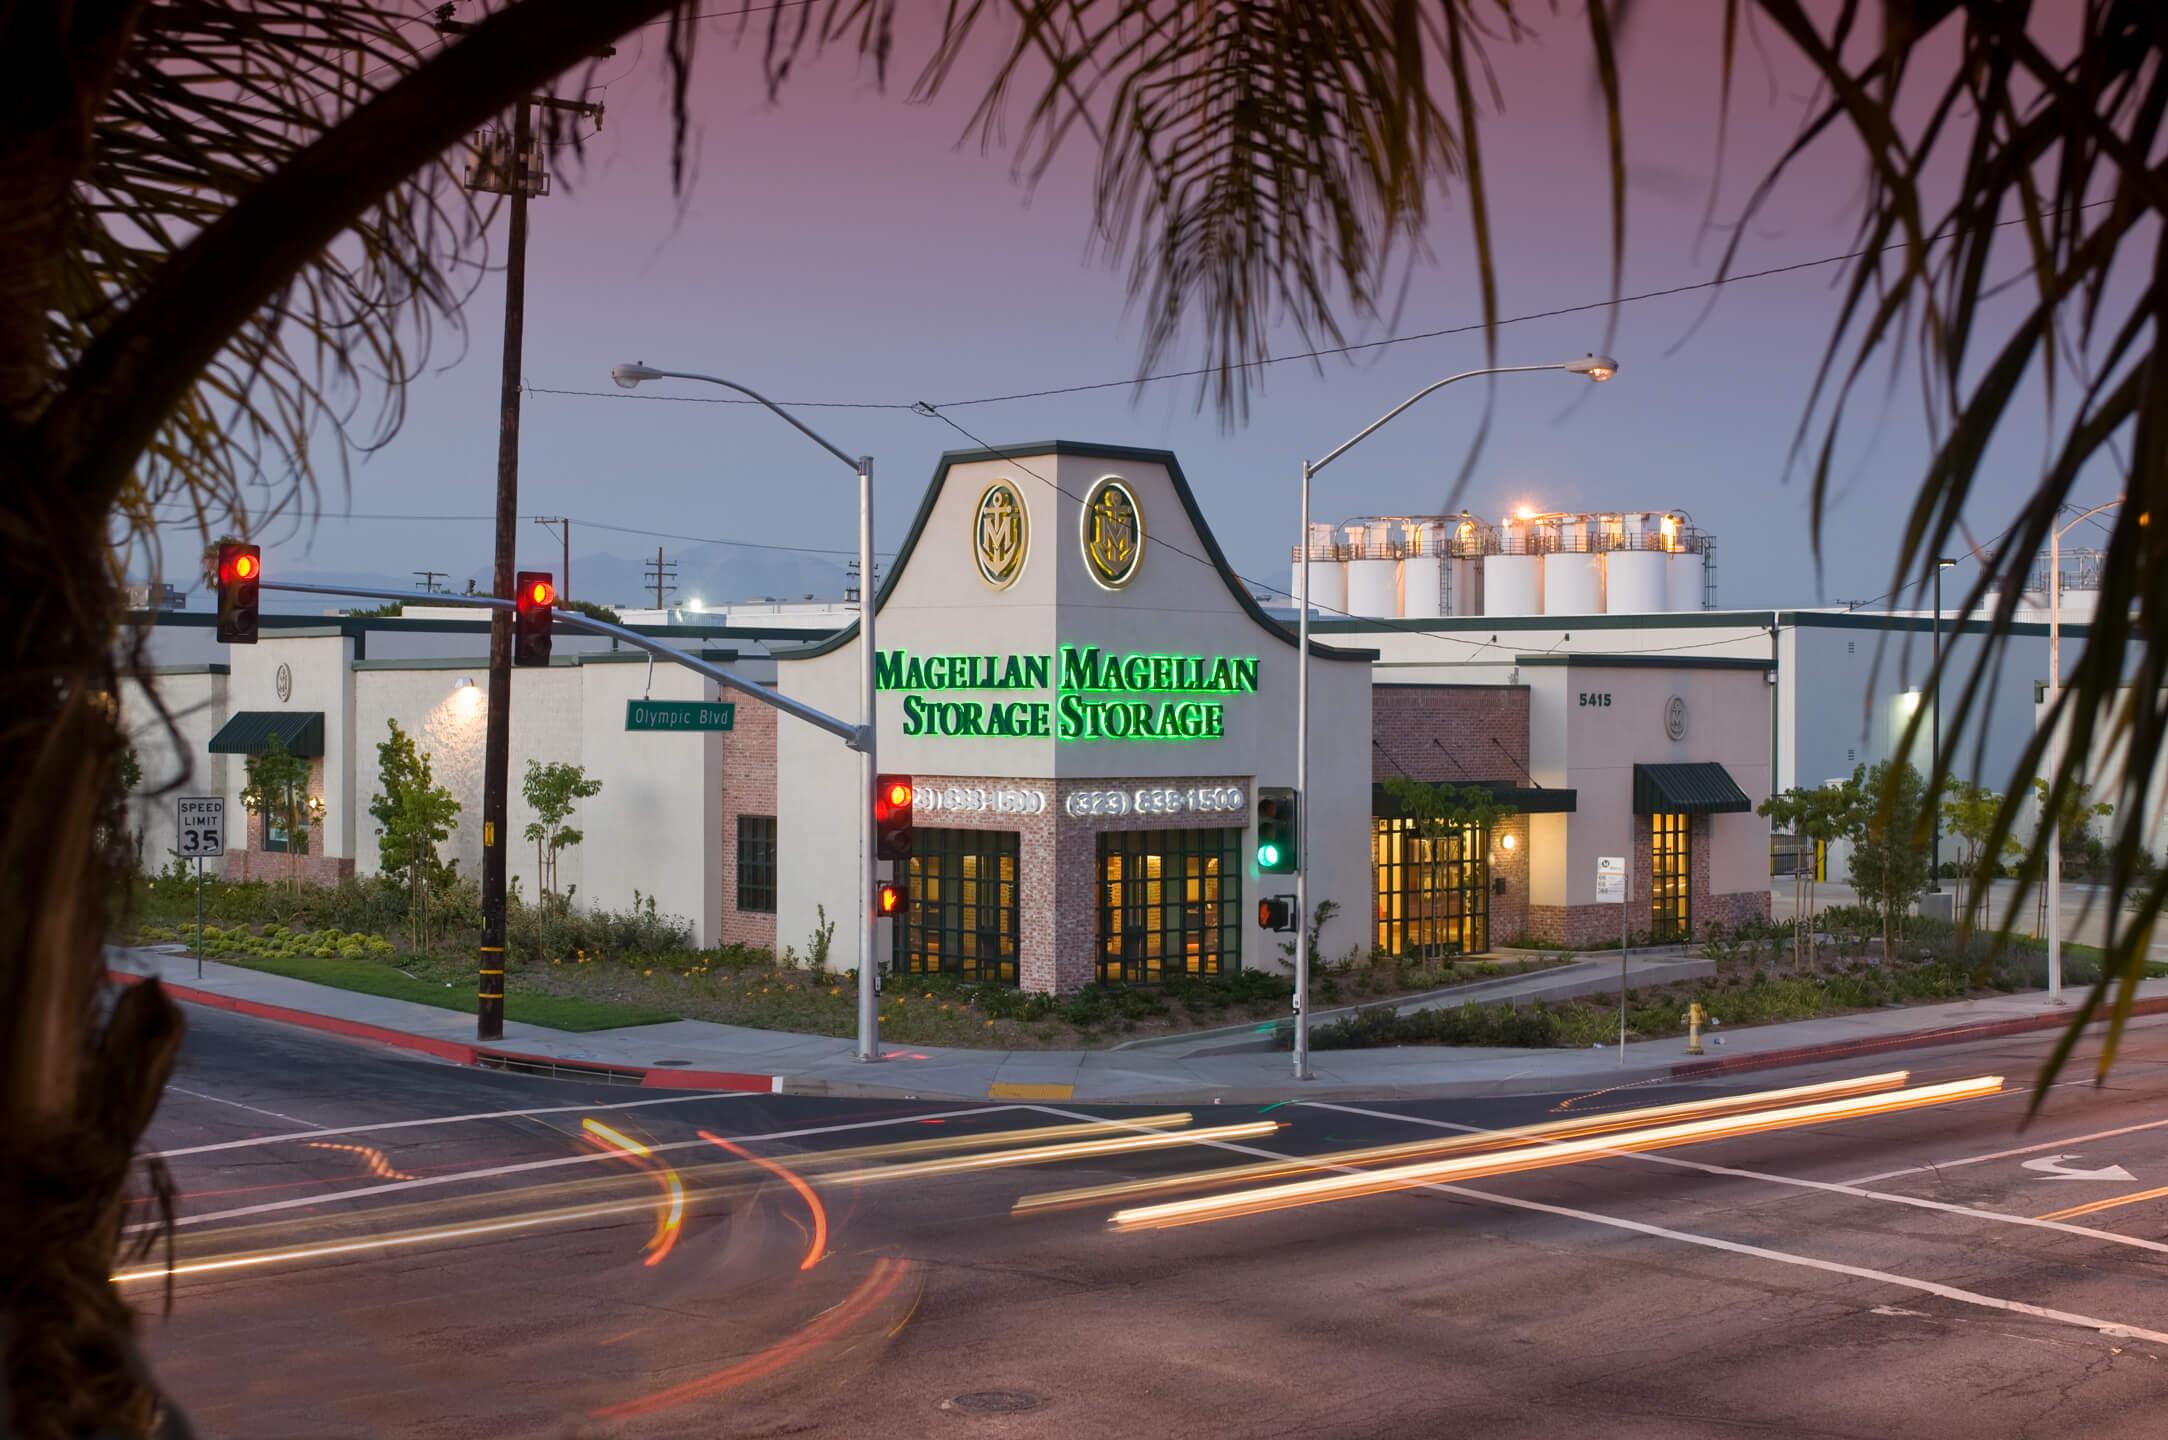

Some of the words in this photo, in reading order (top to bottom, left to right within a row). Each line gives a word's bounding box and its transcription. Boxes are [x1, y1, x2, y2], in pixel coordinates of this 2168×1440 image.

[875, 650, 1051, 690] MAGELLAN
[1061, 648, 1260, 692] MAGELLAN
[1579, 692, 1612, 707] 5415
[635, 708, 691, 727] Olympic
[699, 709, 728, 725] Blvd
[903, 694, 1050, 735] STORAGE
[1059, 694, 1224, 738] STORAGE
[181, 803, 222, 812] SPEED
[1066, 791, 1132, 817] (323)
[184, 816, 217, 826] LIMIT
[183, 829, 219, 851] 35
